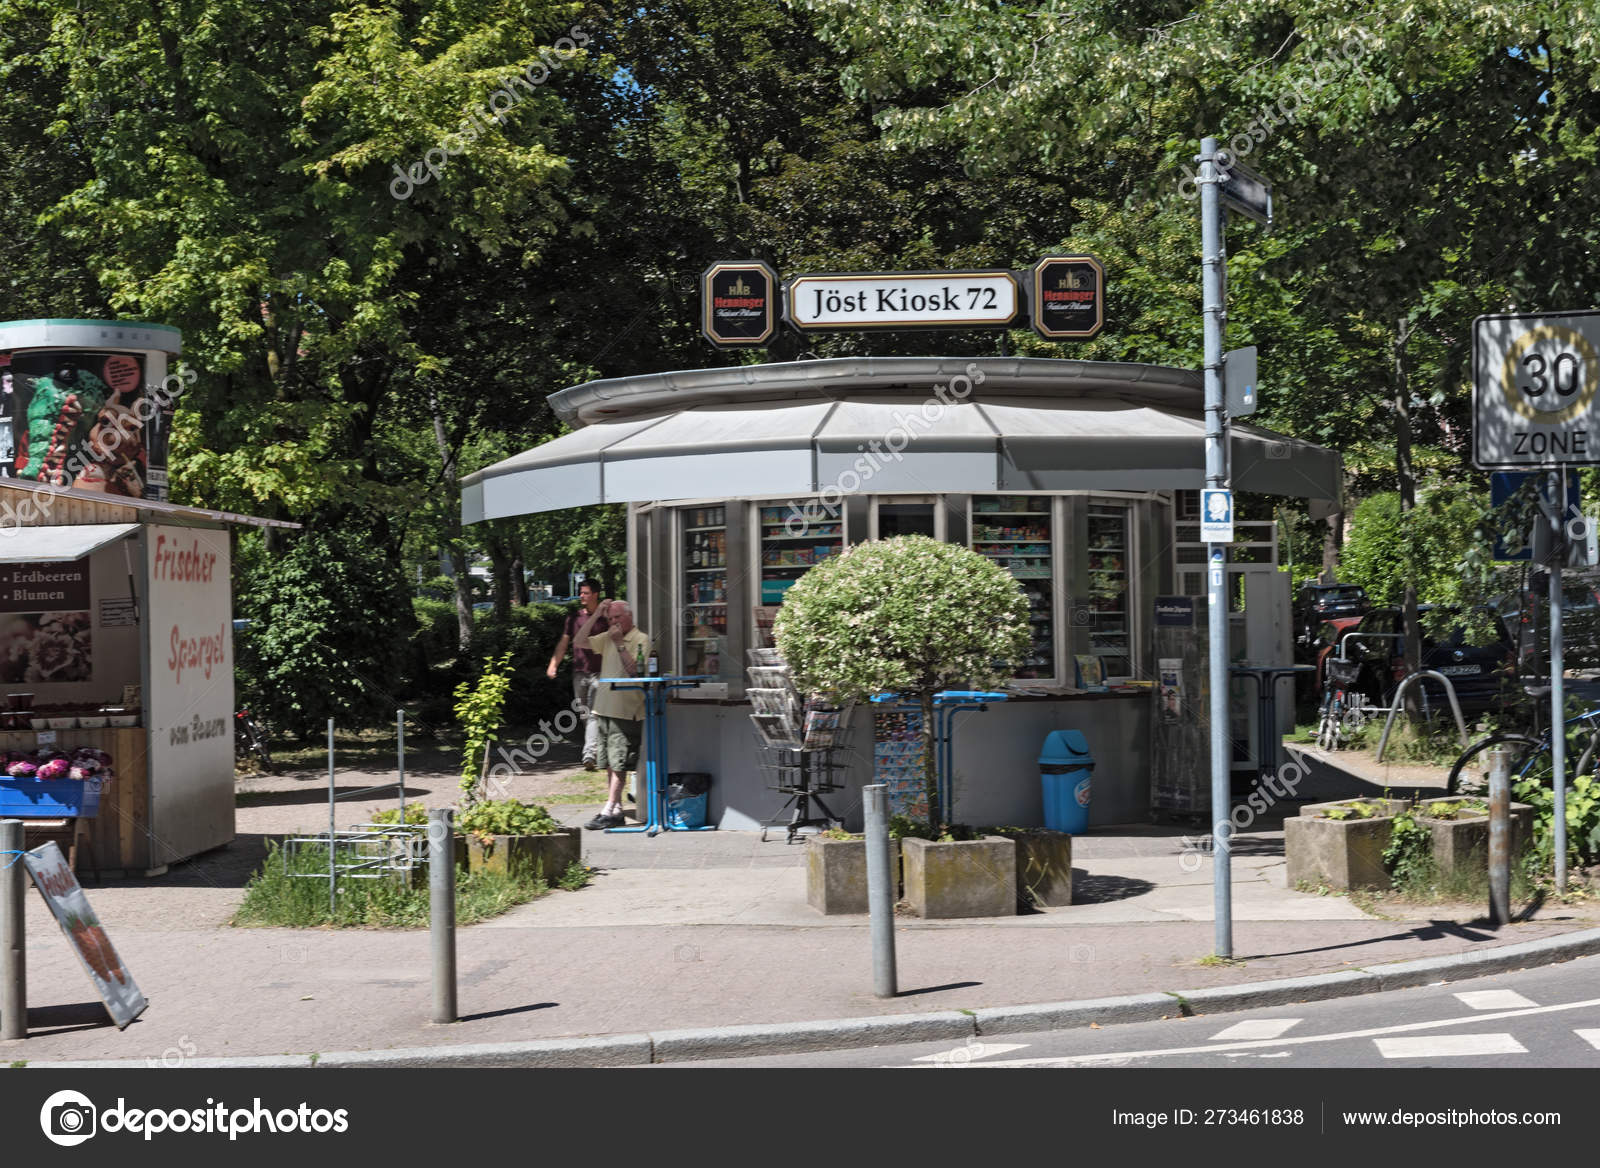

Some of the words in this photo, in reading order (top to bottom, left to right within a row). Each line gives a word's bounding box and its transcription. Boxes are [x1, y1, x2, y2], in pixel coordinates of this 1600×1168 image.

[714, 297, 764, 309] Henninger
[813, 288, 867, 318] Jöst
[876, 286, 960, 312] Kiosk
[966, 287, 998, 310] 72
[1044, 290, 1096, 303] Henninger
[1522, 352, 1578, 397] 30
[1513, 431, 1588, 456] ZONE
[153, 534, 216, 583] Frischer
[13, 570, 82, 583] Erdbeeren
[13, 588, 65, 601] Blumen
[168, 623, 225, 685] Spargel
